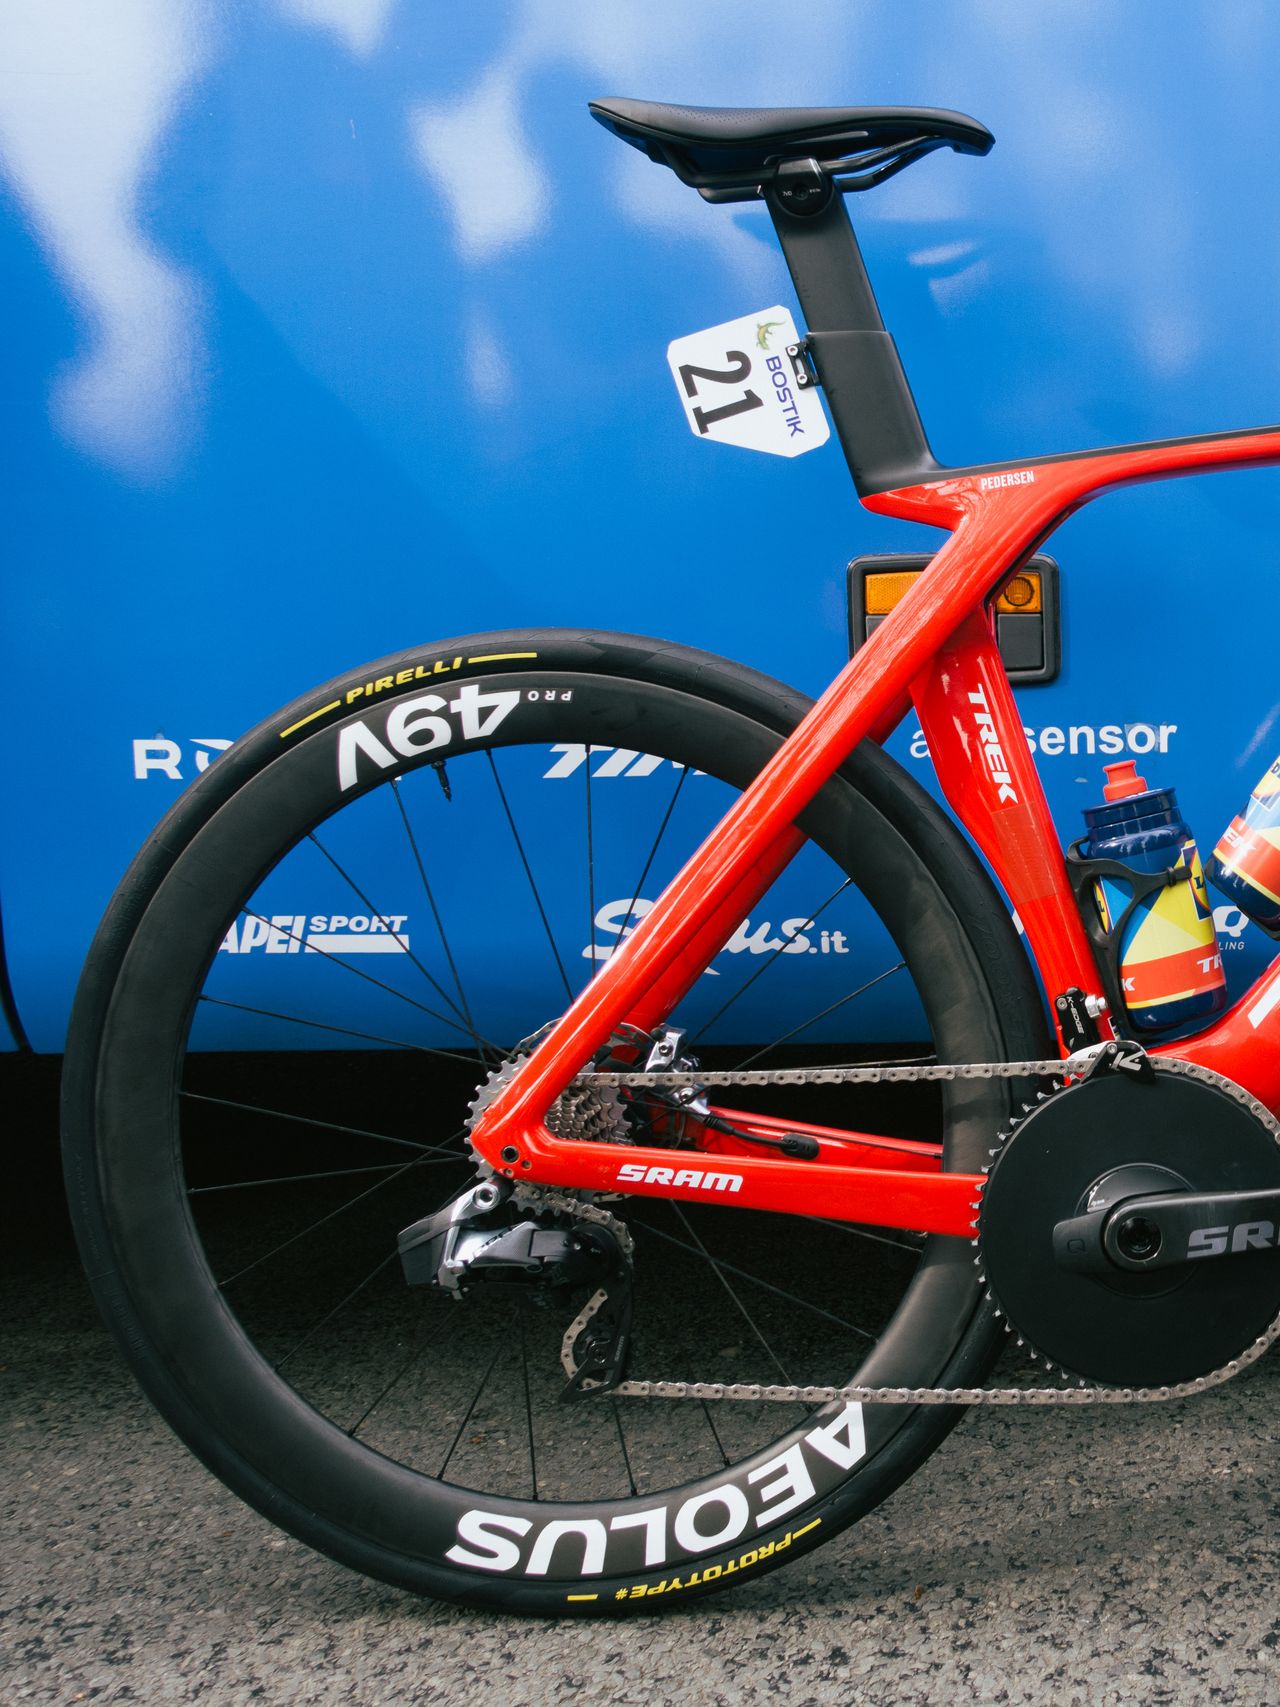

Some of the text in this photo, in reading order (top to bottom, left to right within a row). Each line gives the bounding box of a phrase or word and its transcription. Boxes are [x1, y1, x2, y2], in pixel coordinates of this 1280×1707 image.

[679, 351, 763, 434] 21
[766, 356, 804, 437] BOSTIK
[981, 471, 1034, 490] PEDERSEN
[346, 657, 462, 704] PIRELLI
[338, 684, 573, 792] PRO 49V
[968, 683, 1018, 804] TREK
[308, 915, 408, 933] SPORT
[1066, 996, 1085, 1034] K-EDGE
[617, 1163, 743, 1193] SRAM
[444, 1401, 868, 1575] AEOLUS
